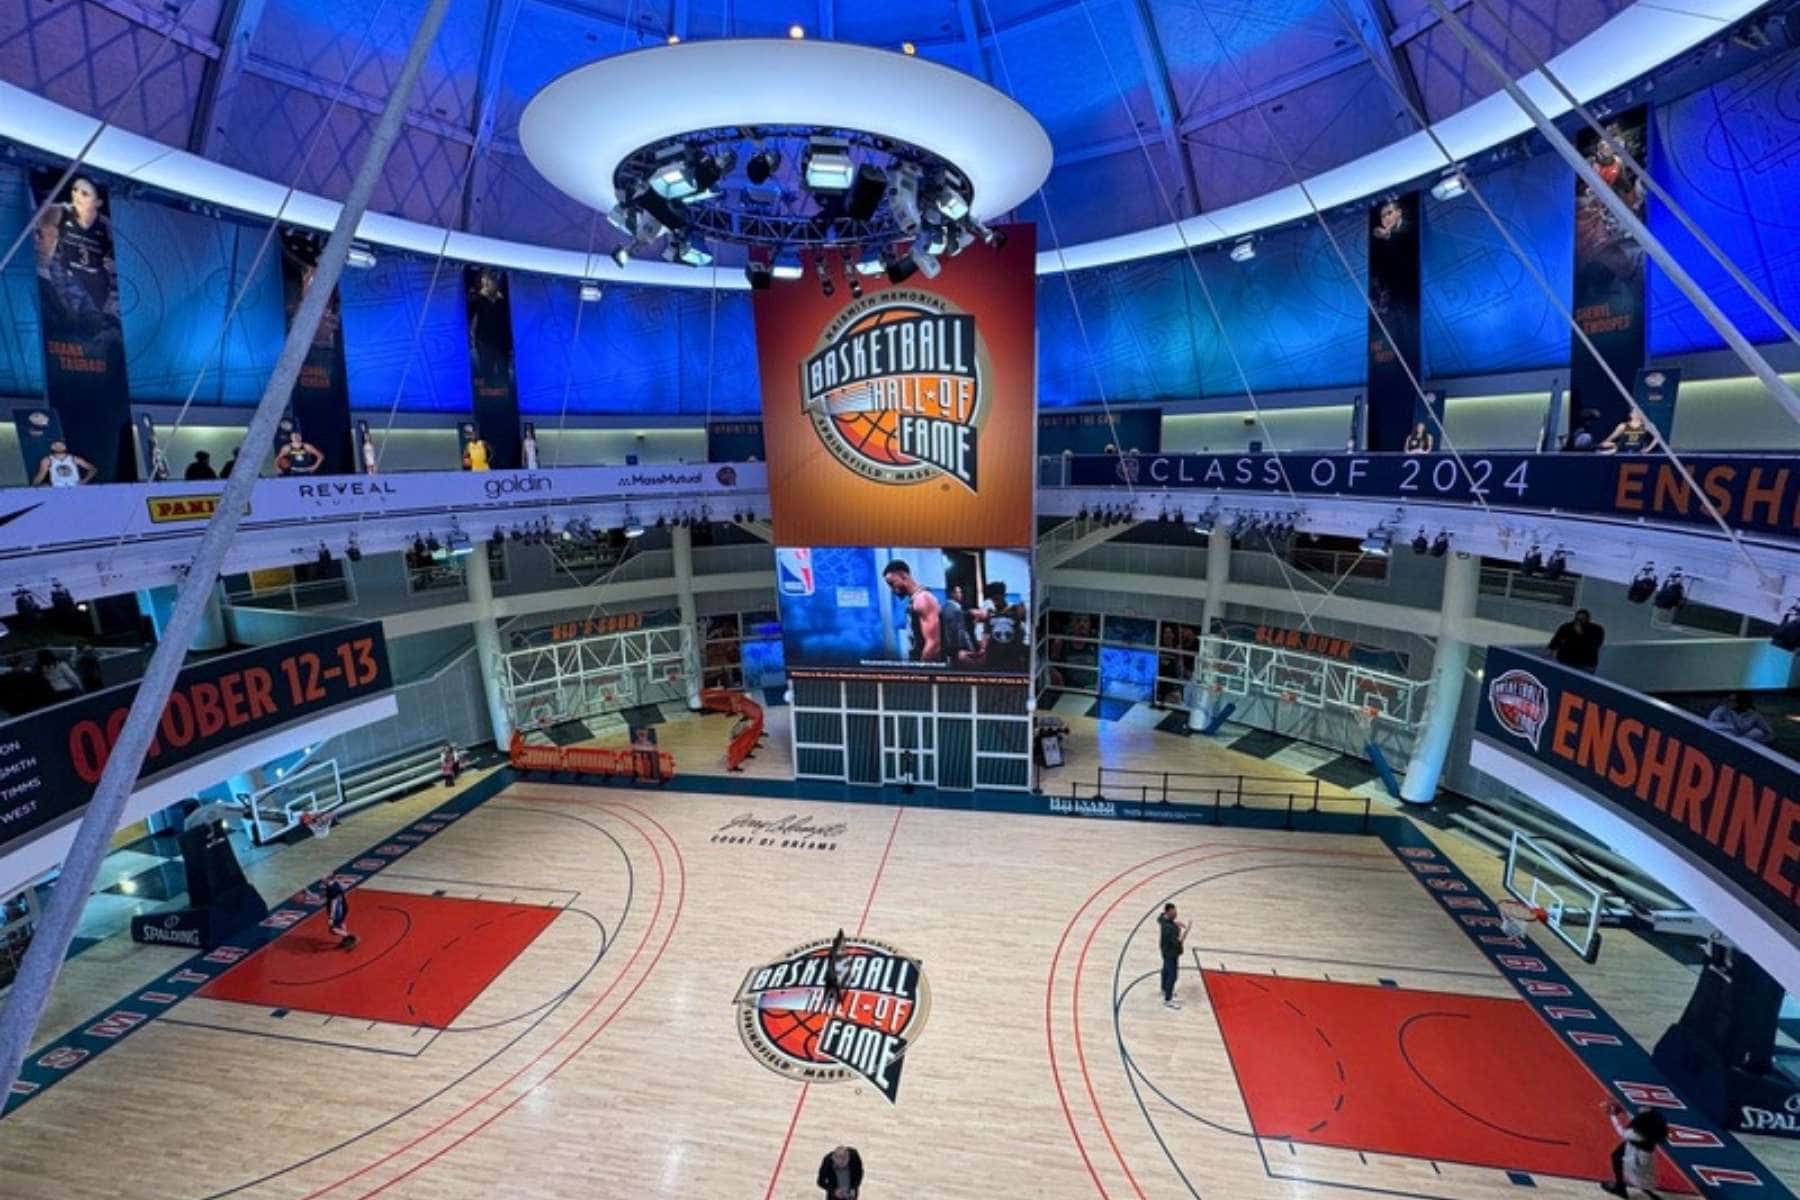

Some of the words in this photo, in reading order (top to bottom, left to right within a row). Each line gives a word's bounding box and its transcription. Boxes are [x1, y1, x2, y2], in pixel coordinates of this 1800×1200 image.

[880, 293, 947, 311] MEMORIAL
[811, 319, 969, 394] BASKETBALL
[872, 378, 925, 418] HALL
[938, 378, 970, 420] OF
[818, 418, 883, 478] SPRINGFIELD
[902, 416, 971, 481] FAME
[299, 480, 397, 498] REVEAL
[484, 474, 553, 499] goldin
[632, 472, 703, 487] MassMutual
[1151, 457, 1284, 483] CLASS
[1310, 457, 1370, 488] OF
[1399, 458, 1529, 497] 2024
[1615, 462, 1800, 529] ENSH
[157, 500, 218, 517] PANI
[68, 664, 279, 784] OOBER
[280, 636, 380, 706] 12-13
[0, 800, 38, 824] WEST
[1551, 690, 1800, 907] ENSHRINE
[143, 924, 200, 945] SPALDING
[1397, 846, 1624, 1047] BASKETBALL
[873, 996, 907, 1031] OF
[824, 1019, 899, 1090] FAME
